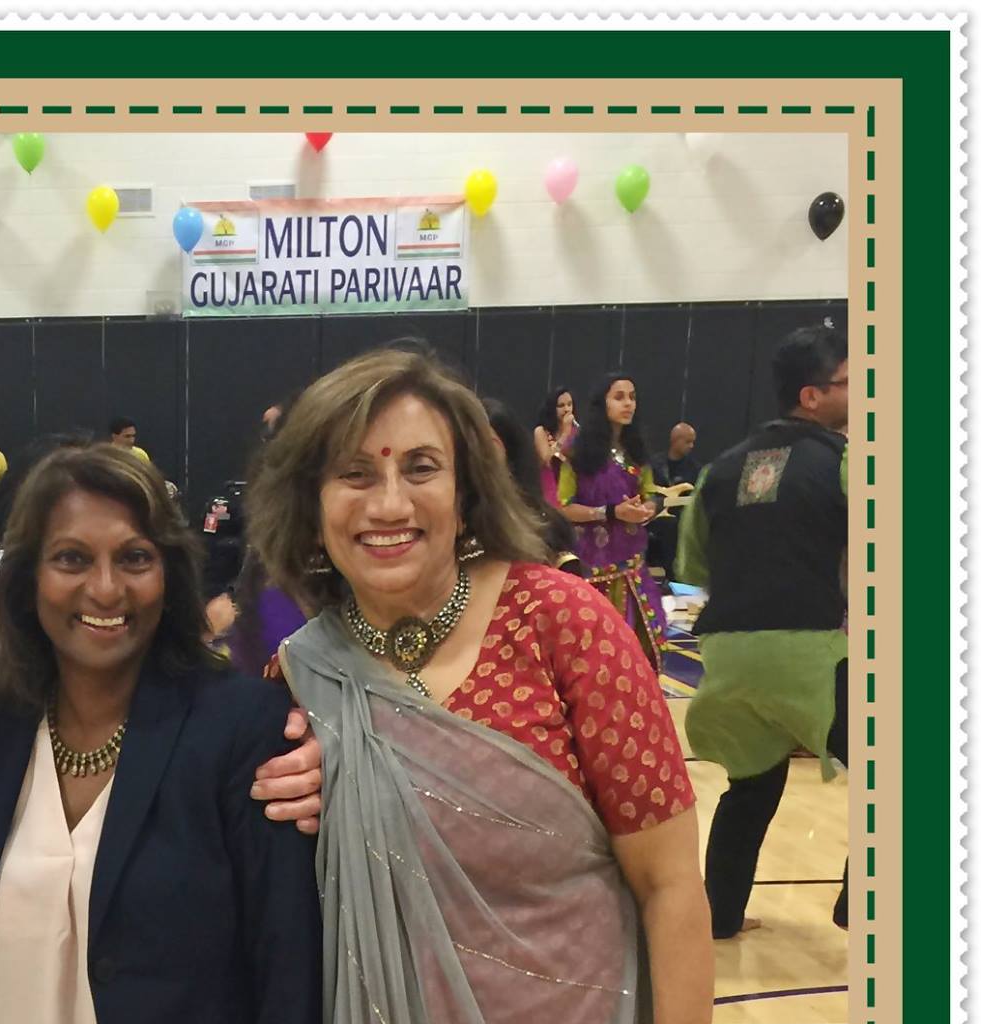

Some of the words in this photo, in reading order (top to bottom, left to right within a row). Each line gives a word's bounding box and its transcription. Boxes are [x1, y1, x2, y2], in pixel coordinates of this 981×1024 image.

[265, 214, 388, 259] MILTON
[190, 269, 319, 308] GUJARATI
[330, 264, 462, 304] PARIVAAR
